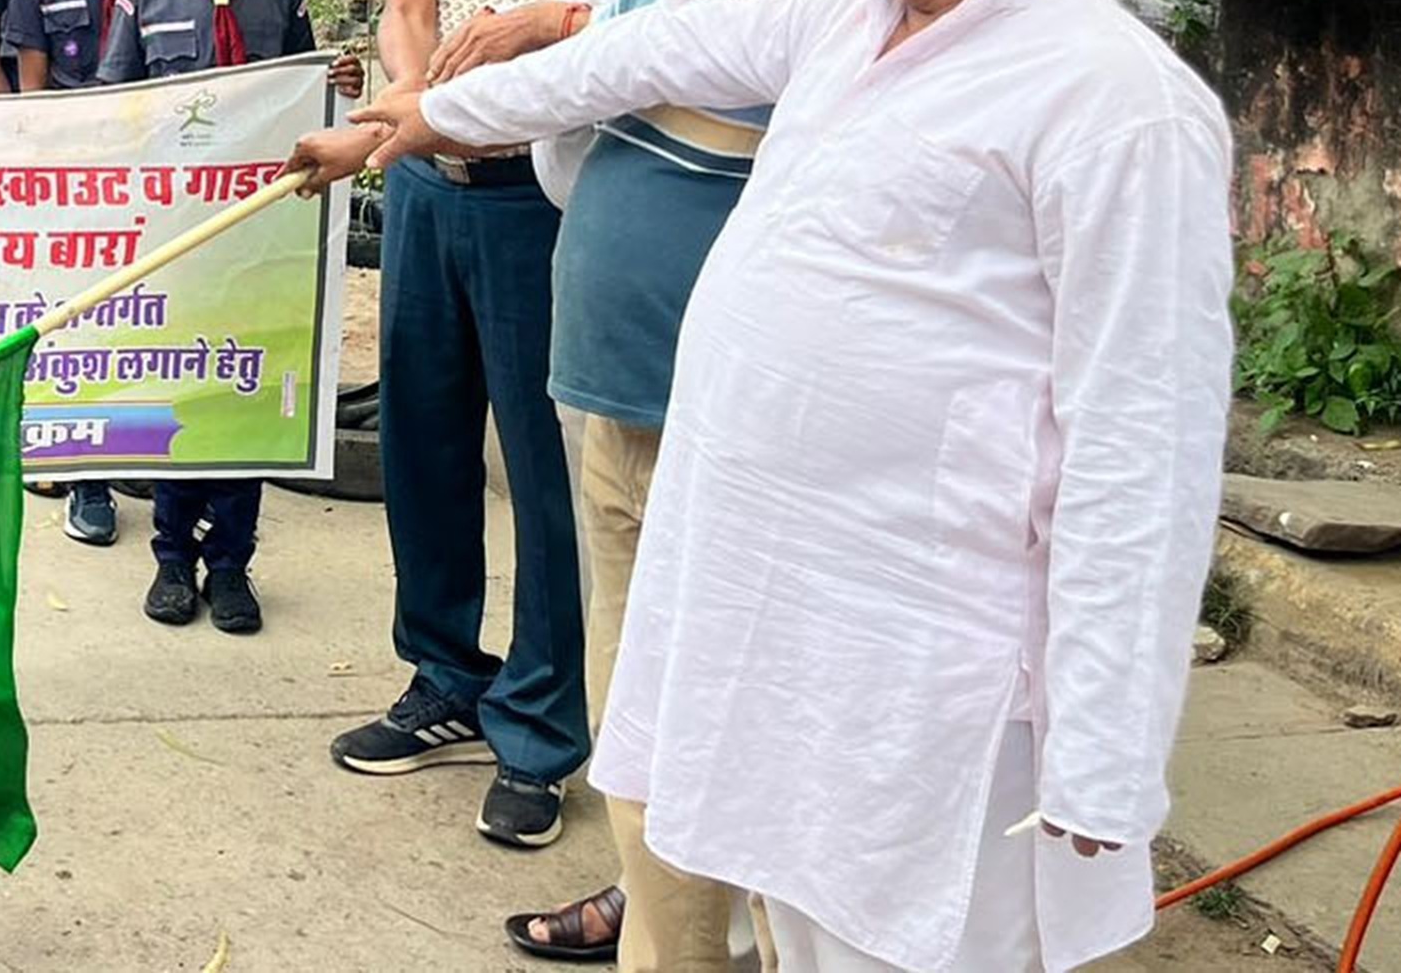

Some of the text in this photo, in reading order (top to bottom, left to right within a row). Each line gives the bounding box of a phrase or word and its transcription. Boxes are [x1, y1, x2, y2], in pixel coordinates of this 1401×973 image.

[140, 166, 176, 206] व
[46, 215, 146, 270] बारां
[14, 291, 47, 329] के
[55, 282, 167, 329] न्तर्गत
[117, 337, 210, 380] लगाने
[216, 337, 264, 393] हेतु
